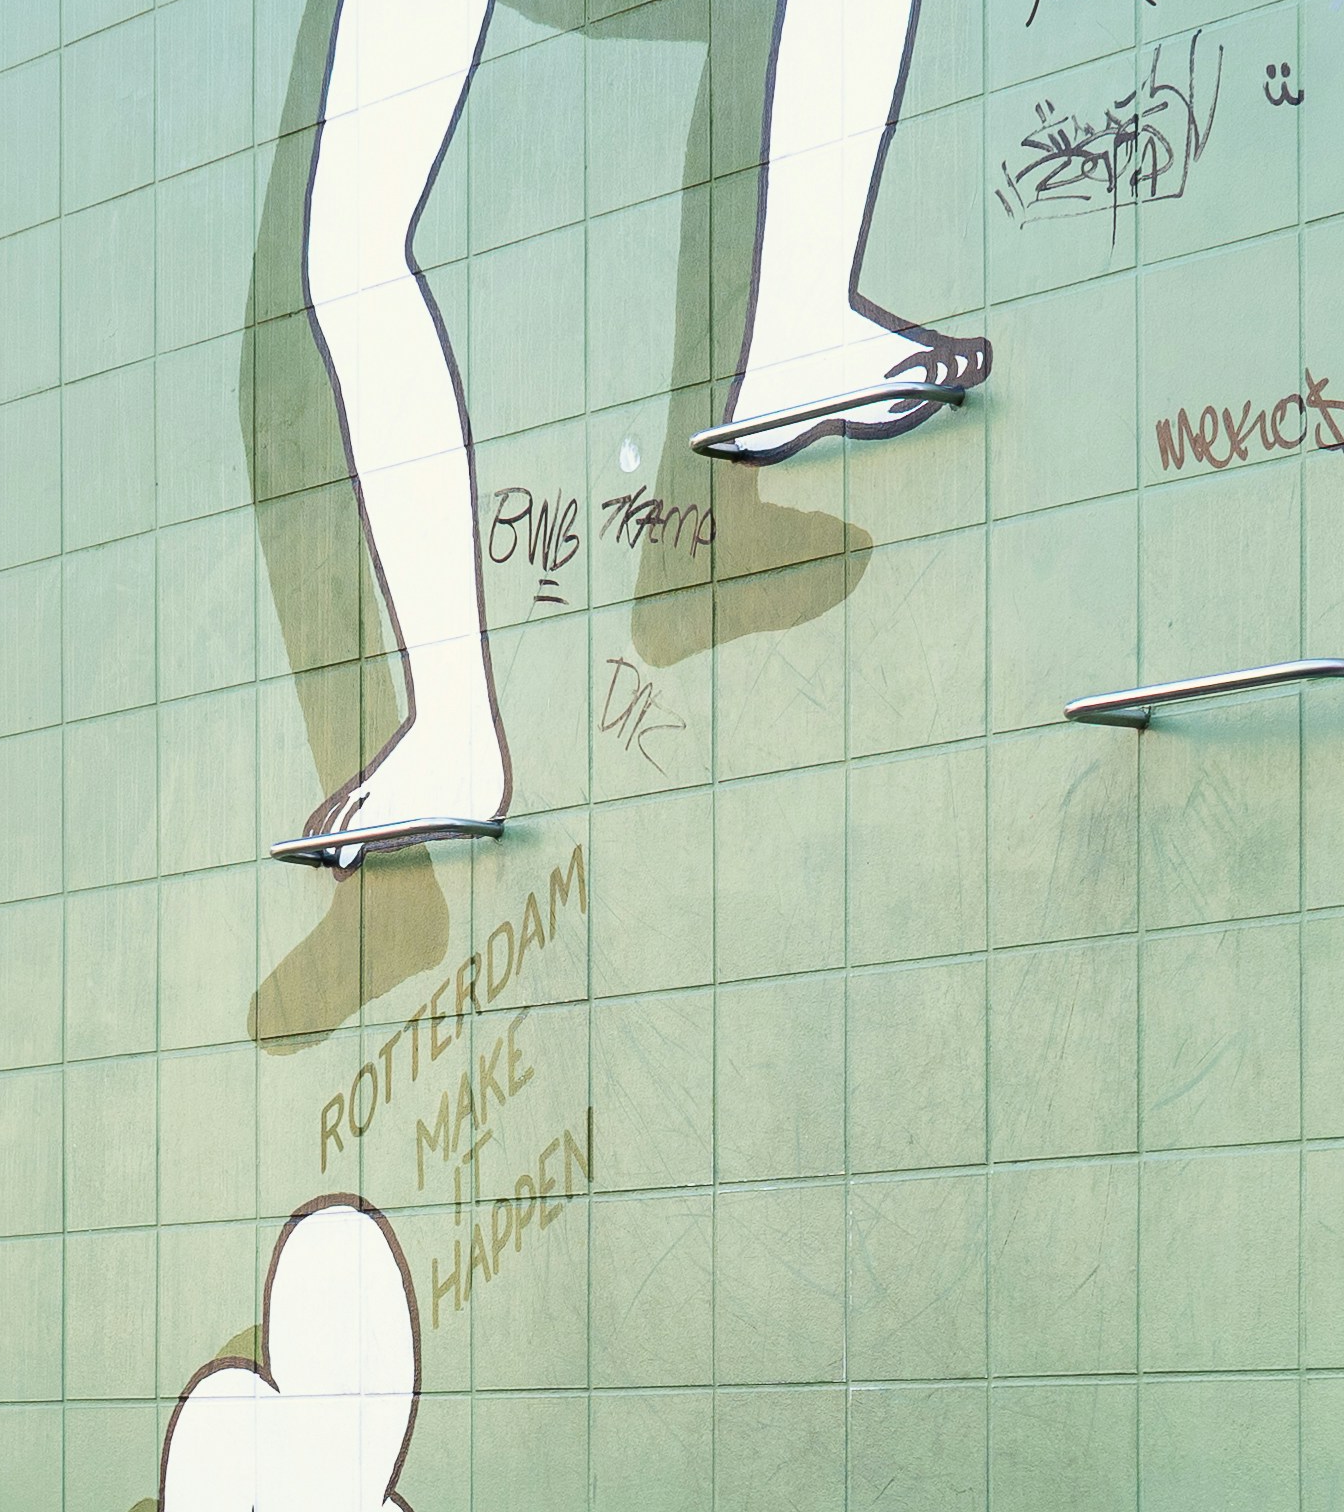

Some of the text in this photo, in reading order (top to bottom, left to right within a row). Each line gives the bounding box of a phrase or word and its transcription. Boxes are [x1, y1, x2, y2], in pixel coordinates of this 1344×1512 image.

[321, 844, 587, 1173] ROTTERDAM
[416, 1009, 535, 1189] MAKE
[432, 1106, 594, 1328] HAPPEN
[454, 1128, 493, 1225] IT
